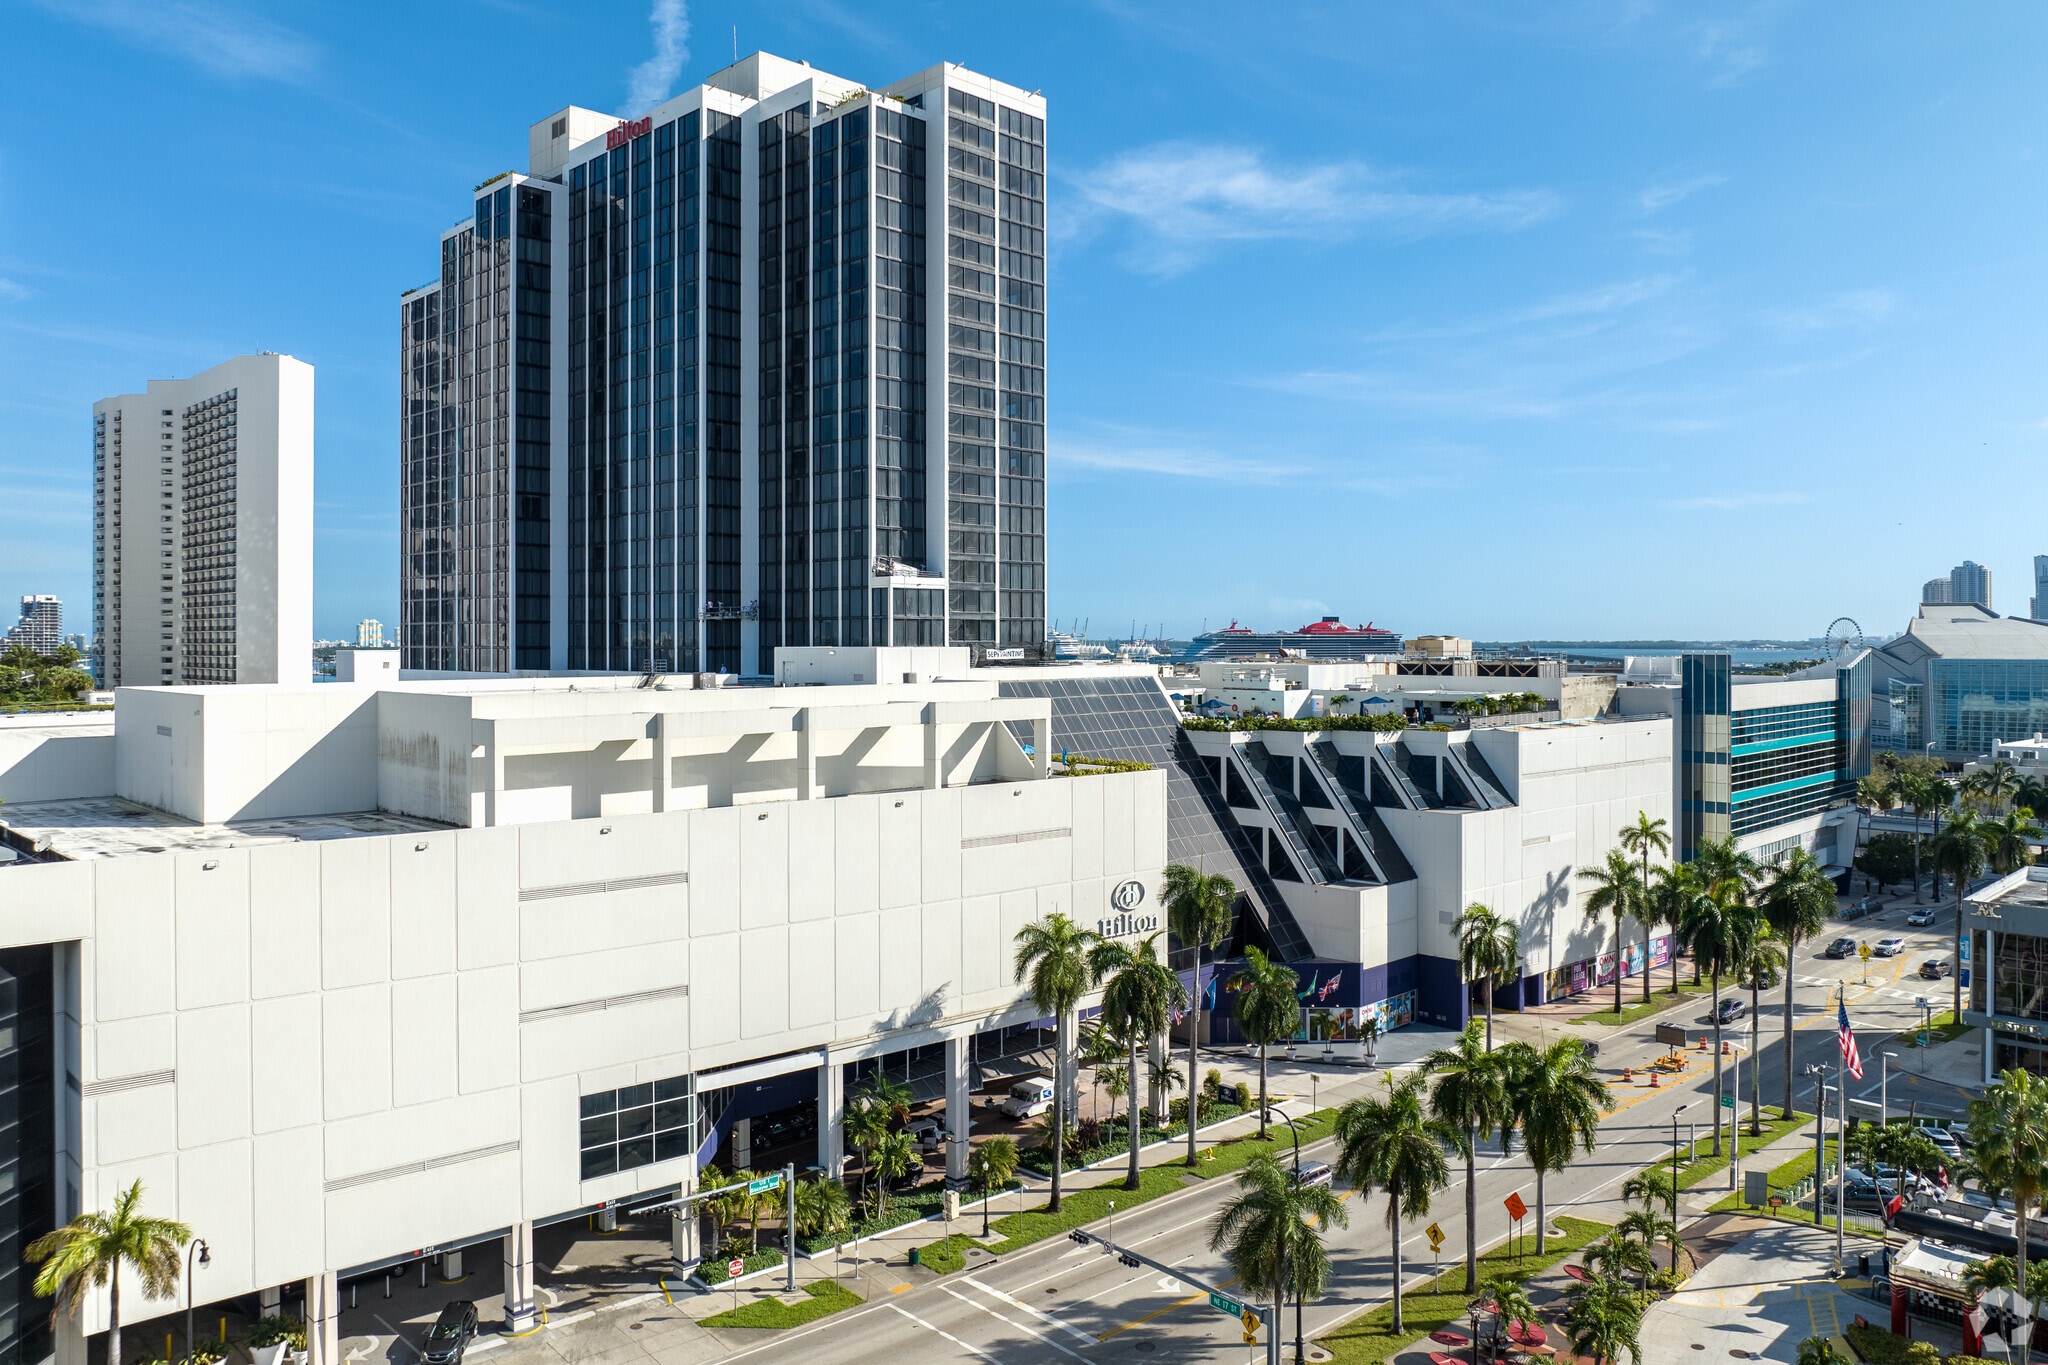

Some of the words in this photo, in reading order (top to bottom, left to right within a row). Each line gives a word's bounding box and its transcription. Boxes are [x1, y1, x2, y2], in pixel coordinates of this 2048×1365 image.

[606, 116, 652, 150] Hilton
[1097, 912, 1159, 939] Hilton
[1223, 1301, 1228, 1309] 17
